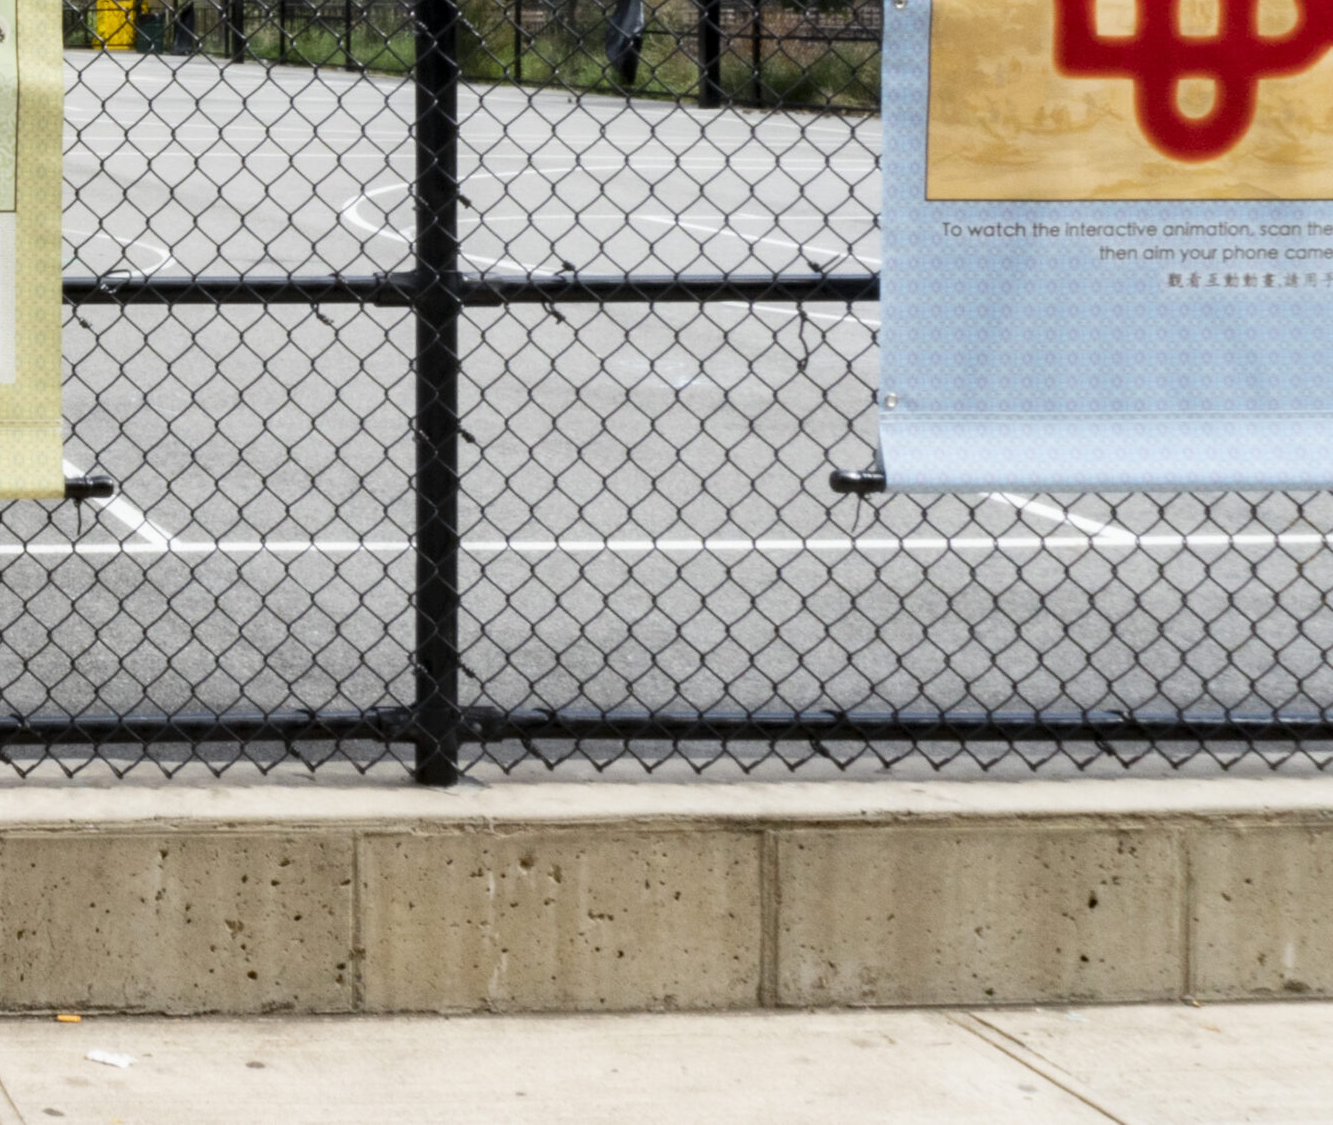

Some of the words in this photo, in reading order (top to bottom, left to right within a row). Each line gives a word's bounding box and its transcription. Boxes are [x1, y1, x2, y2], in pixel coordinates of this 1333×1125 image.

[943, 222, 963, 237] To
[967, 221, 1027, 237] watch
[1033, 221, 1060, 237] the
[1065, 222, 1158, 237] interactive
[1163, 221, 1255, 238] animation,
[1260, 225, 1302, 236] scan
[1100, 245, 1138, 259] then
[1143, 245, 1175, 259] aim
[1179, 248, 1217, 263] your
[1222, 245, 1279, 263] phone
[1285, 248, 1333, 260] came
